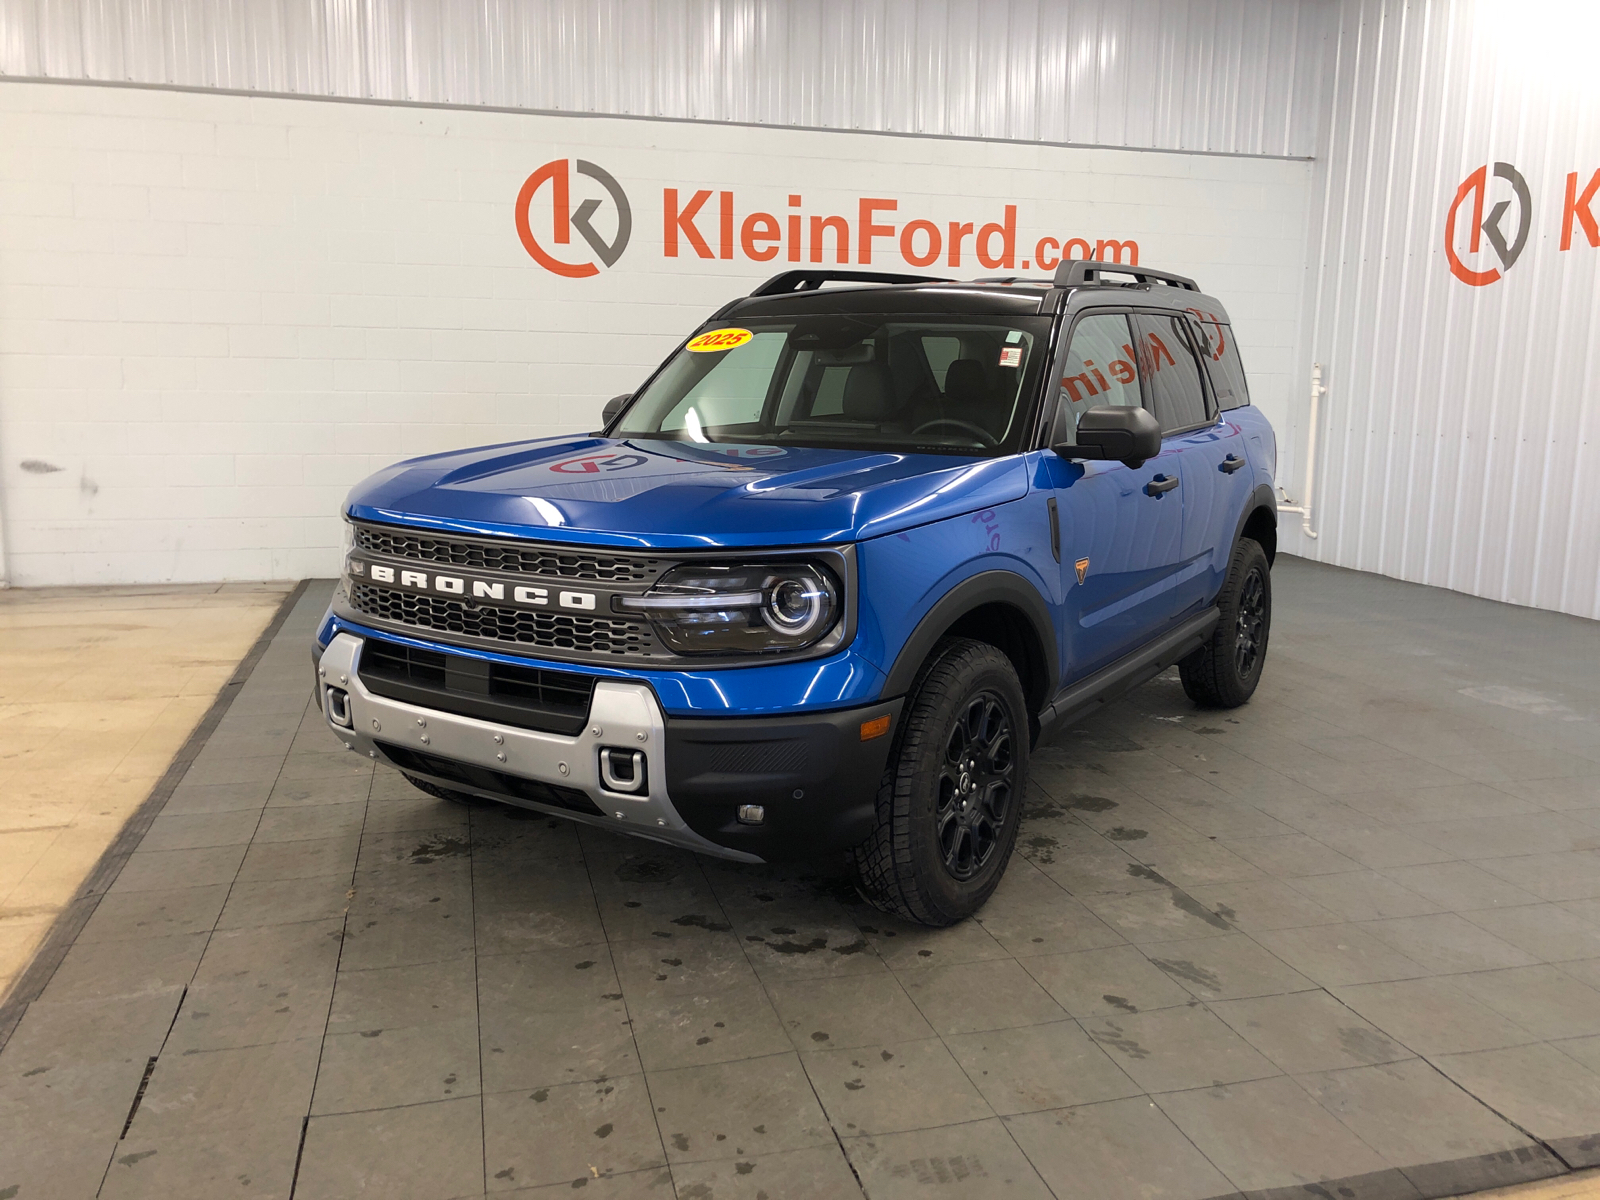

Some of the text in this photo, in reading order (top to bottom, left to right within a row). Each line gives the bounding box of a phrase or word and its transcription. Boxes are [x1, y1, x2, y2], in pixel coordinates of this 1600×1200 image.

[664, 188, 1139, 270] KleinFord.com
[690, 333, 749, 347] 2025
[370, 564, 596, 611] BRONCO
